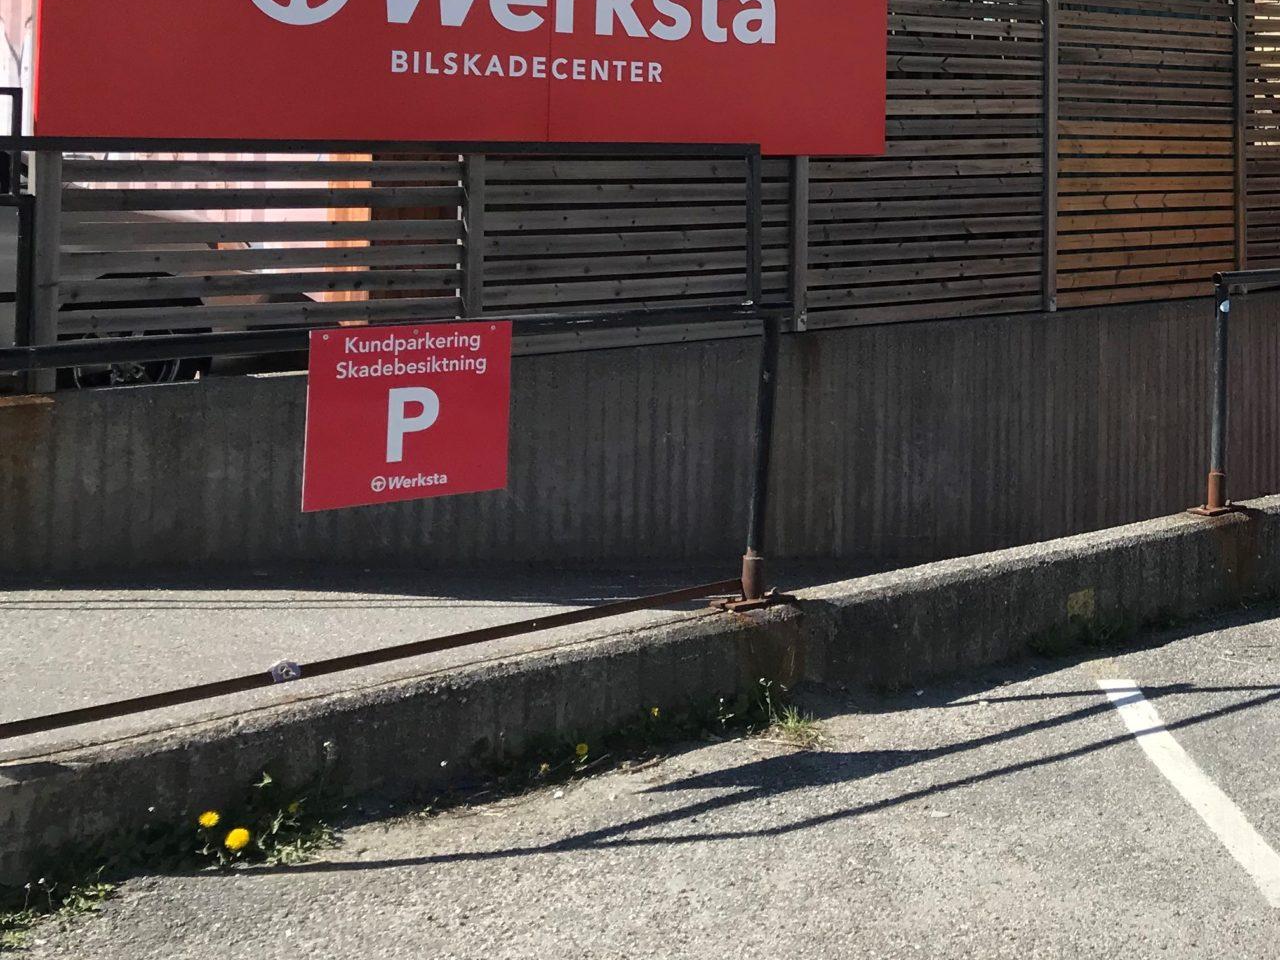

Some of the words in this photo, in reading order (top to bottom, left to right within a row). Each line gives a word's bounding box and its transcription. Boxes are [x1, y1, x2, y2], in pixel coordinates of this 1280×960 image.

[391, 50, 663, 83] BILSKADECENTER
[344, 332, 481, 355] Kundparkering
[336, 355, 487, 379] Skadebesiktning
[386, 386, 440, 463] P
[388, 473, 448, 490] Werksta
